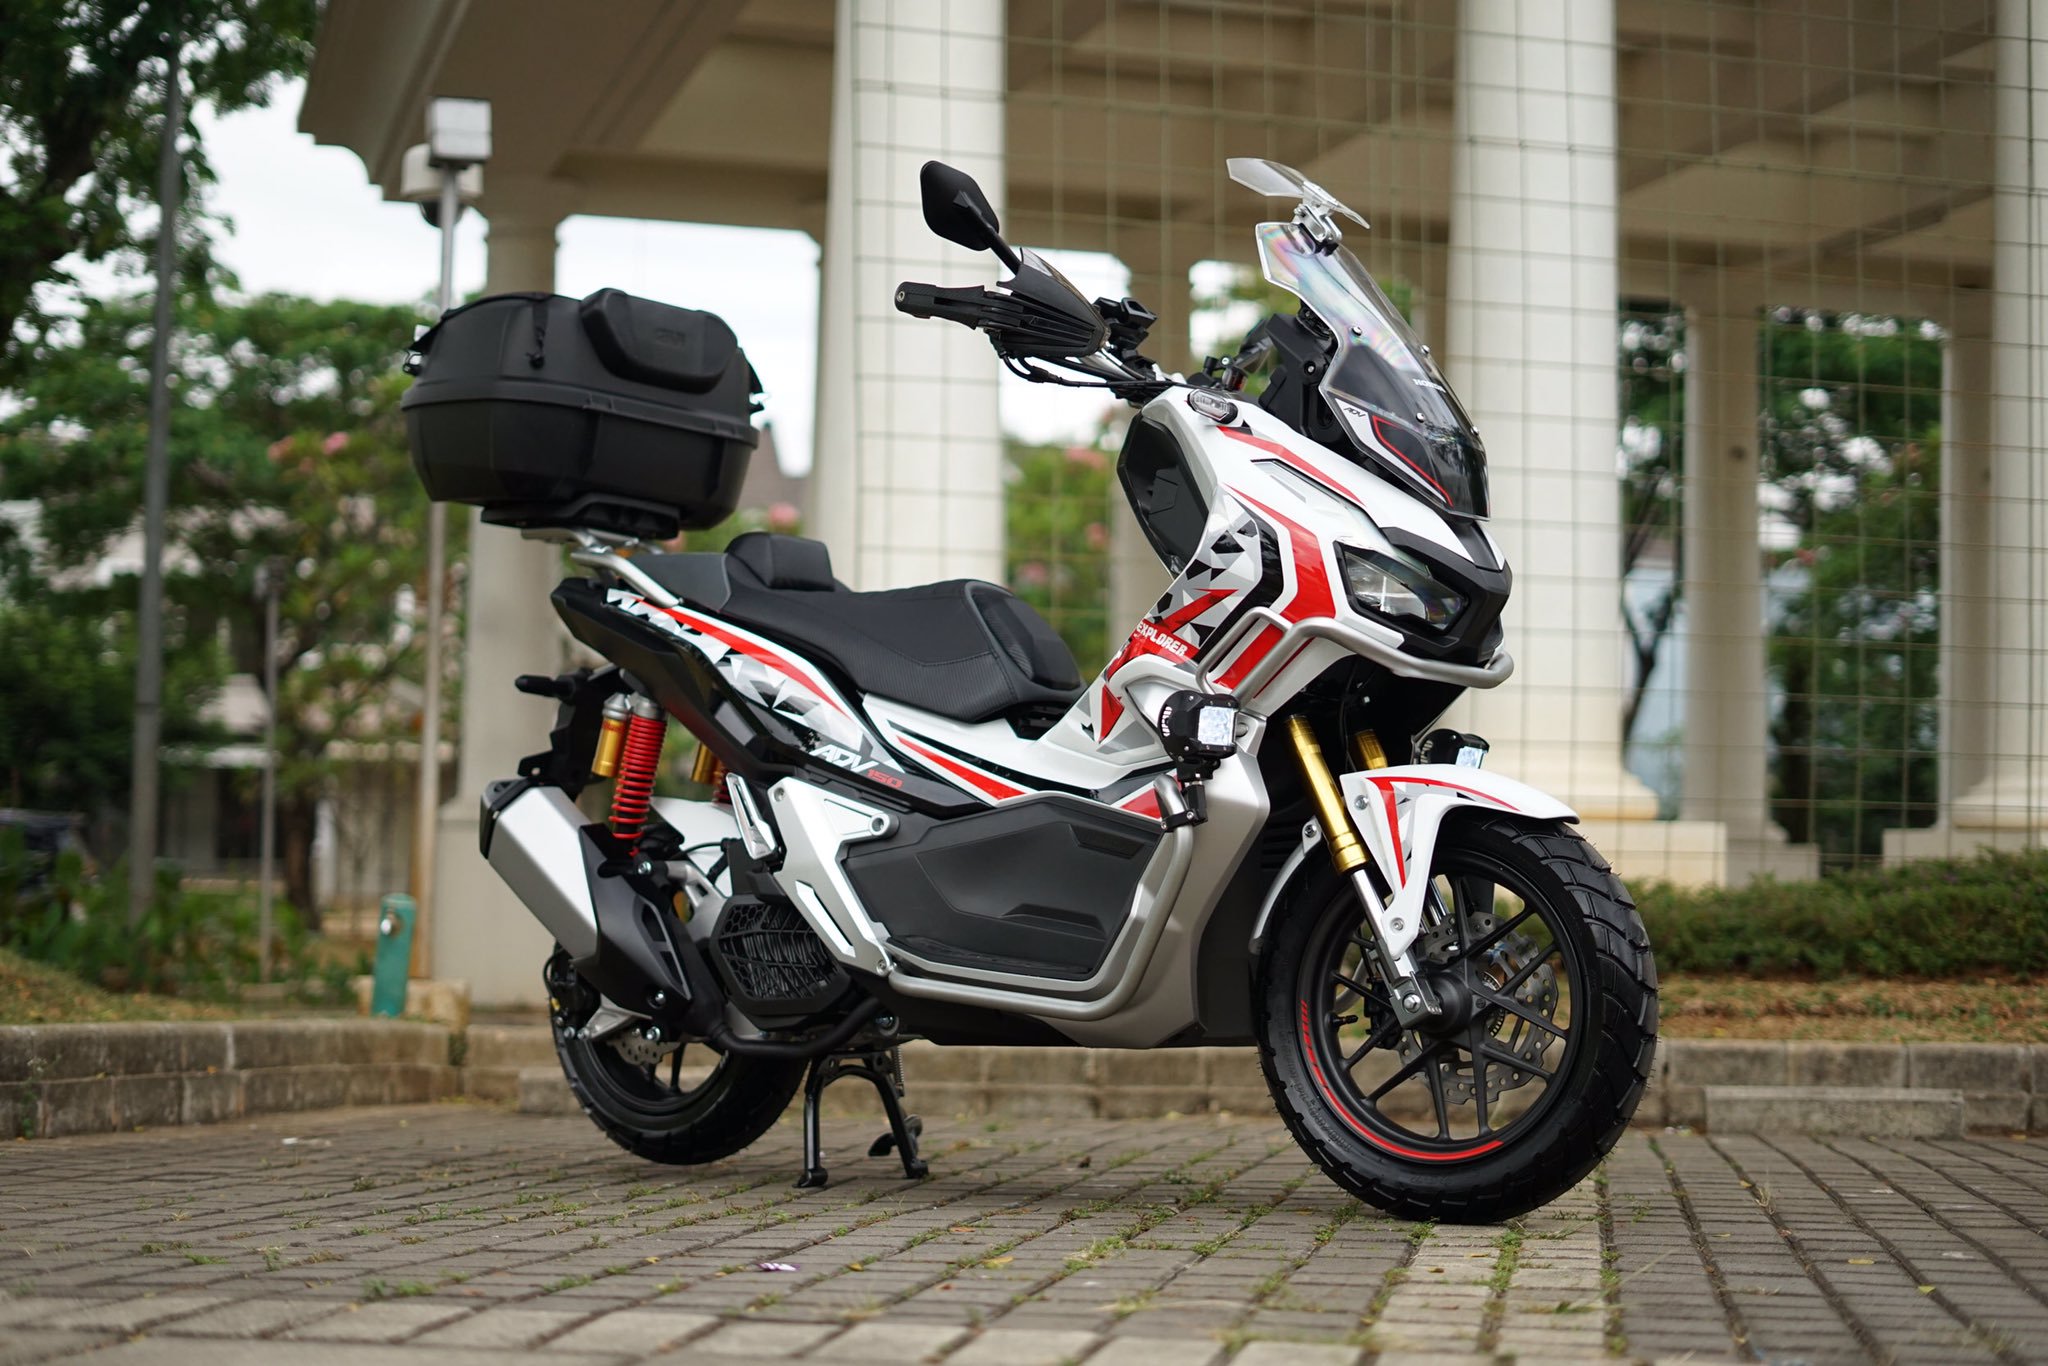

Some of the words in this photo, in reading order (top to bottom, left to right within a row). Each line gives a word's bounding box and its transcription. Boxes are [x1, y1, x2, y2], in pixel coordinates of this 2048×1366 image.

[1344, 407, 1366, 417] ADV
[1136, 620, 1188, 656] EXPLORER
[808, 744, 880, 773] ADV
[867, 768, 903, 789] 150
